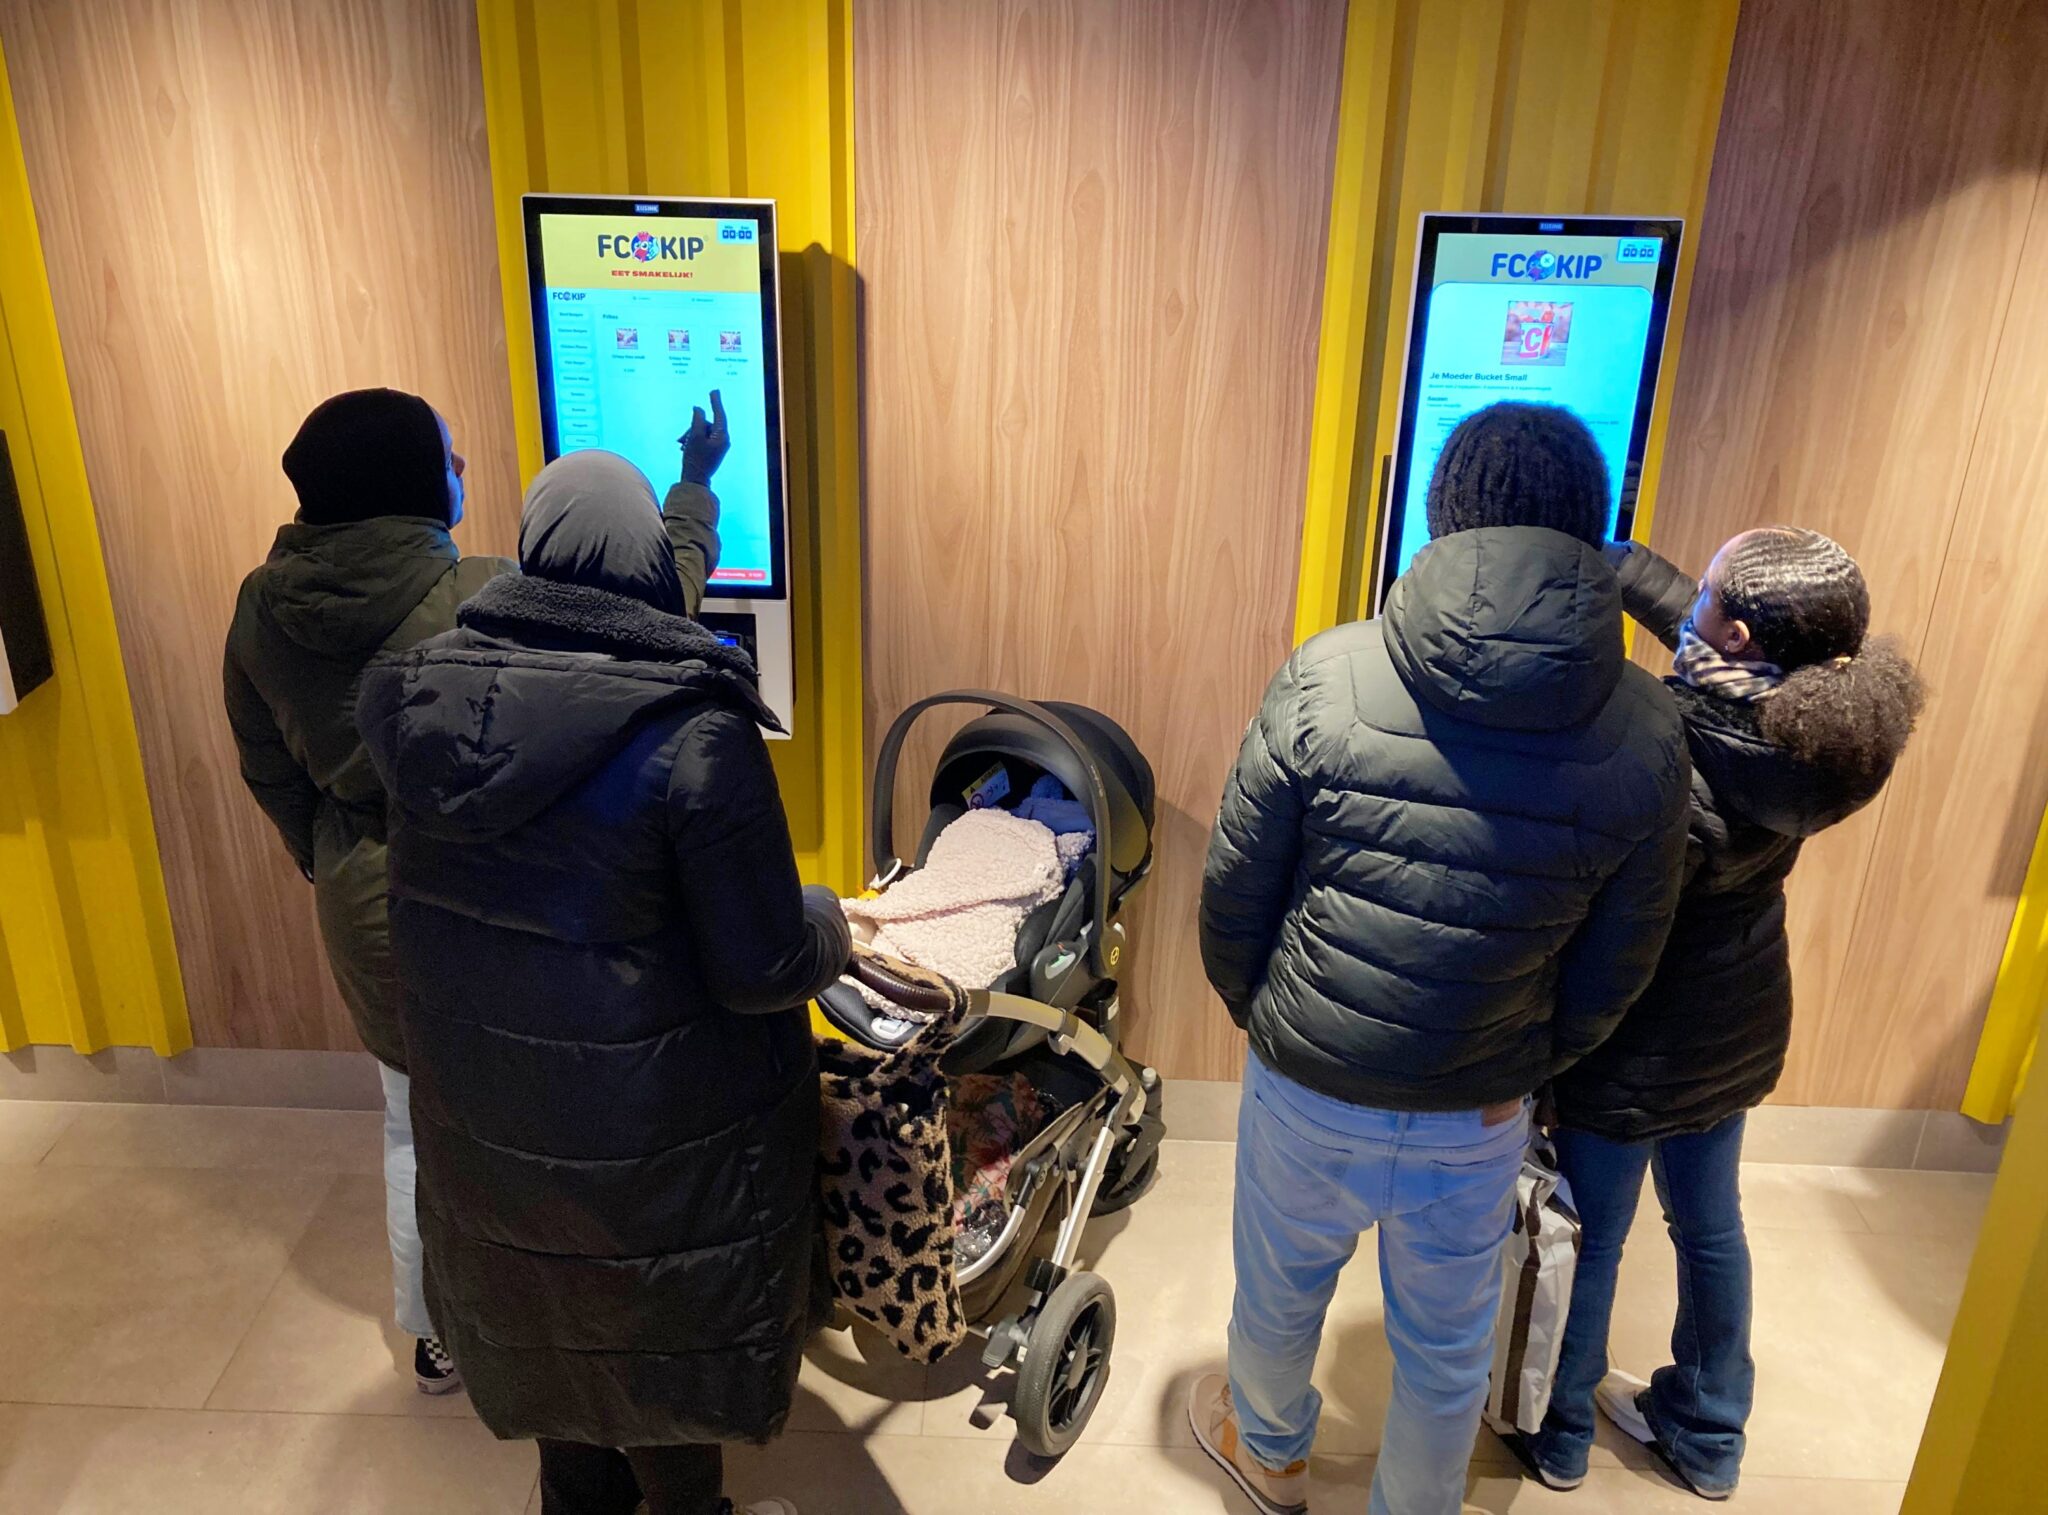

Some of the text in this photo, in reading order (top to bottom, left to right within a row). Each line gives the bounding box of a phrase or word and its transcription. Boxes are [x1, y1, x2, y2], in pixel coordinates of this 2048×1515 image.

[660, 236, 704, 260] KIP
[632, 270, 693, 279] SMAKELIJK!
[1555, 254, 1602, 279] KIP
[1441, 372, 1473, 380] Moeder
[1474, 373, 1503, 381] Bucket
[1504, 373, 1528, 381] Small
